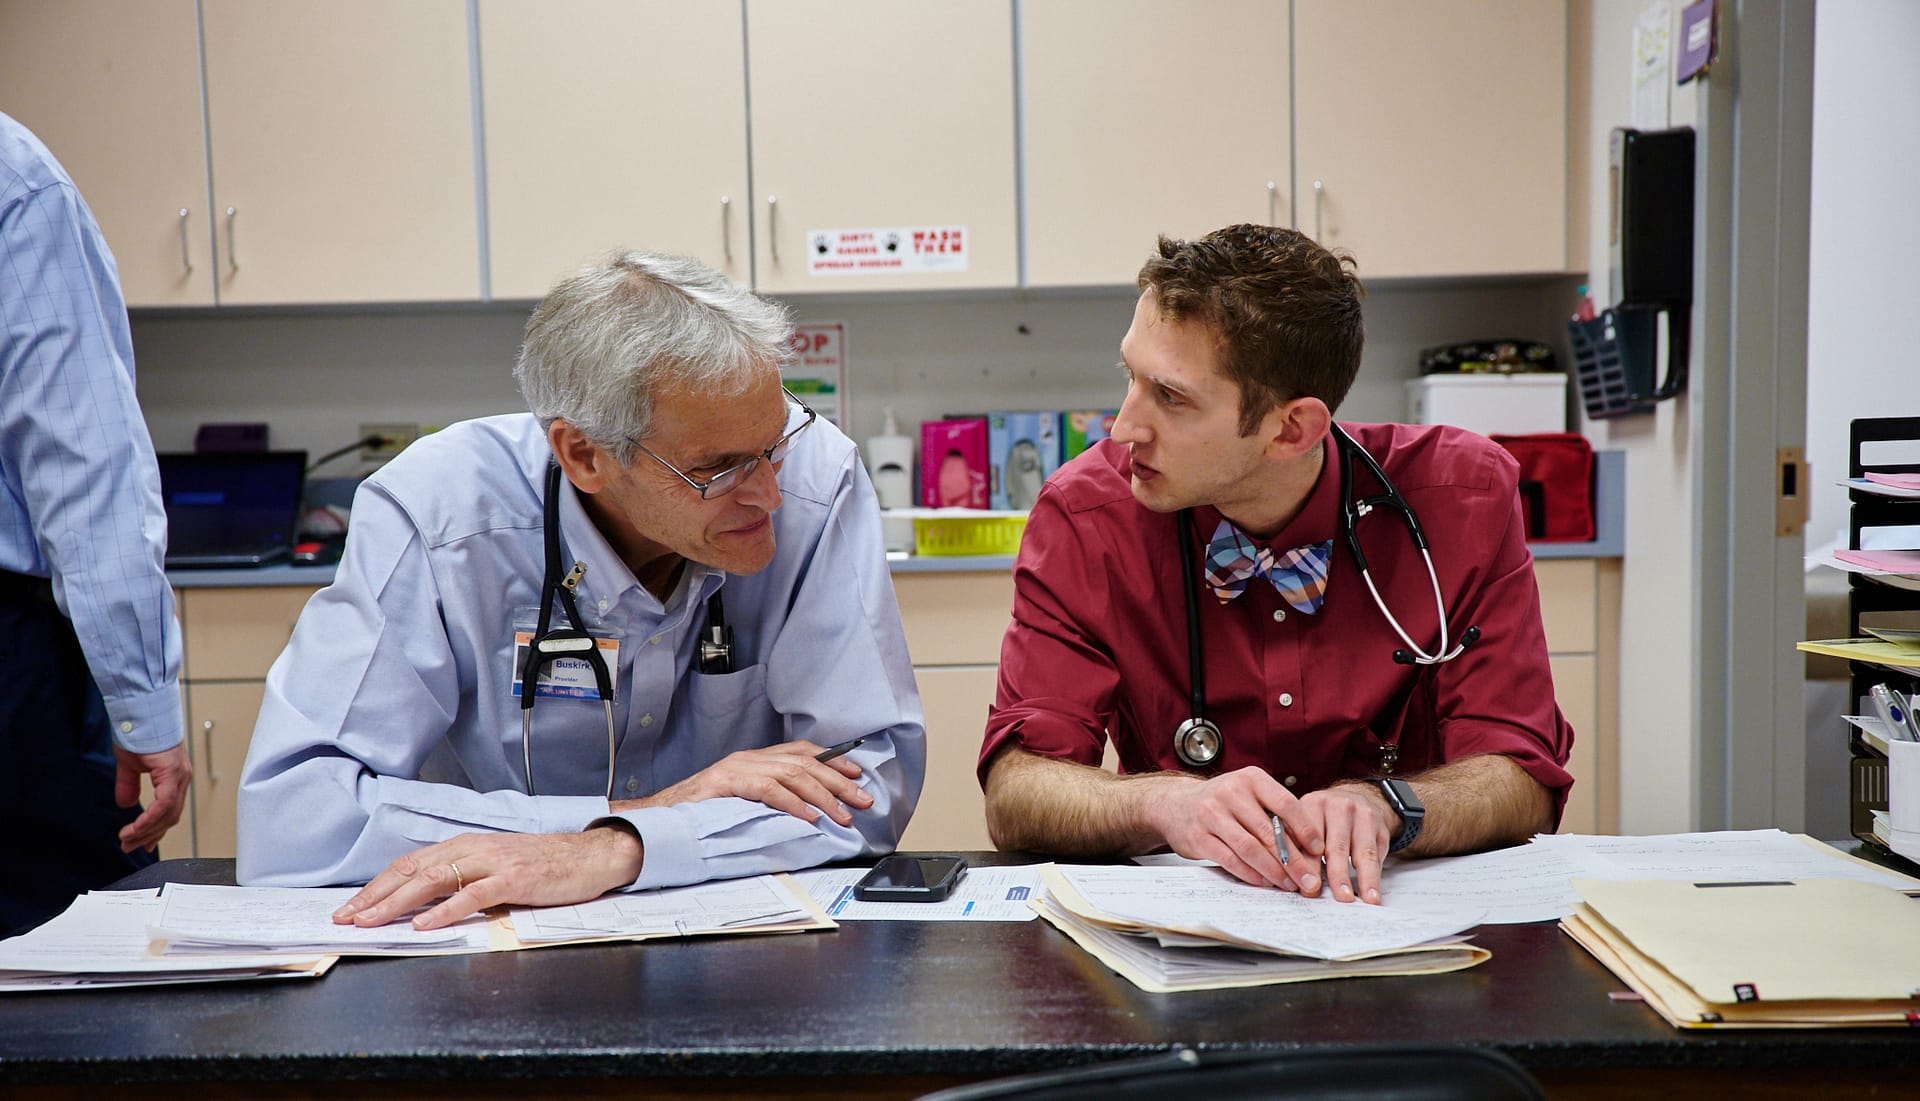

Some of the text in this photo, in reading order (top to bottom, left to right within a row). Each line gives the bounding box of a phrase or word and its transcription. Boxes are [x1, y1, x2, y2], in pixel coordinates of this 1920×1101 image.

[839, 233, 875, 242] DIRTY
[912, 230, 962, 241] WASH
[913, 243, 962, 254] THEM
[789, 332, 829, 353] OP
